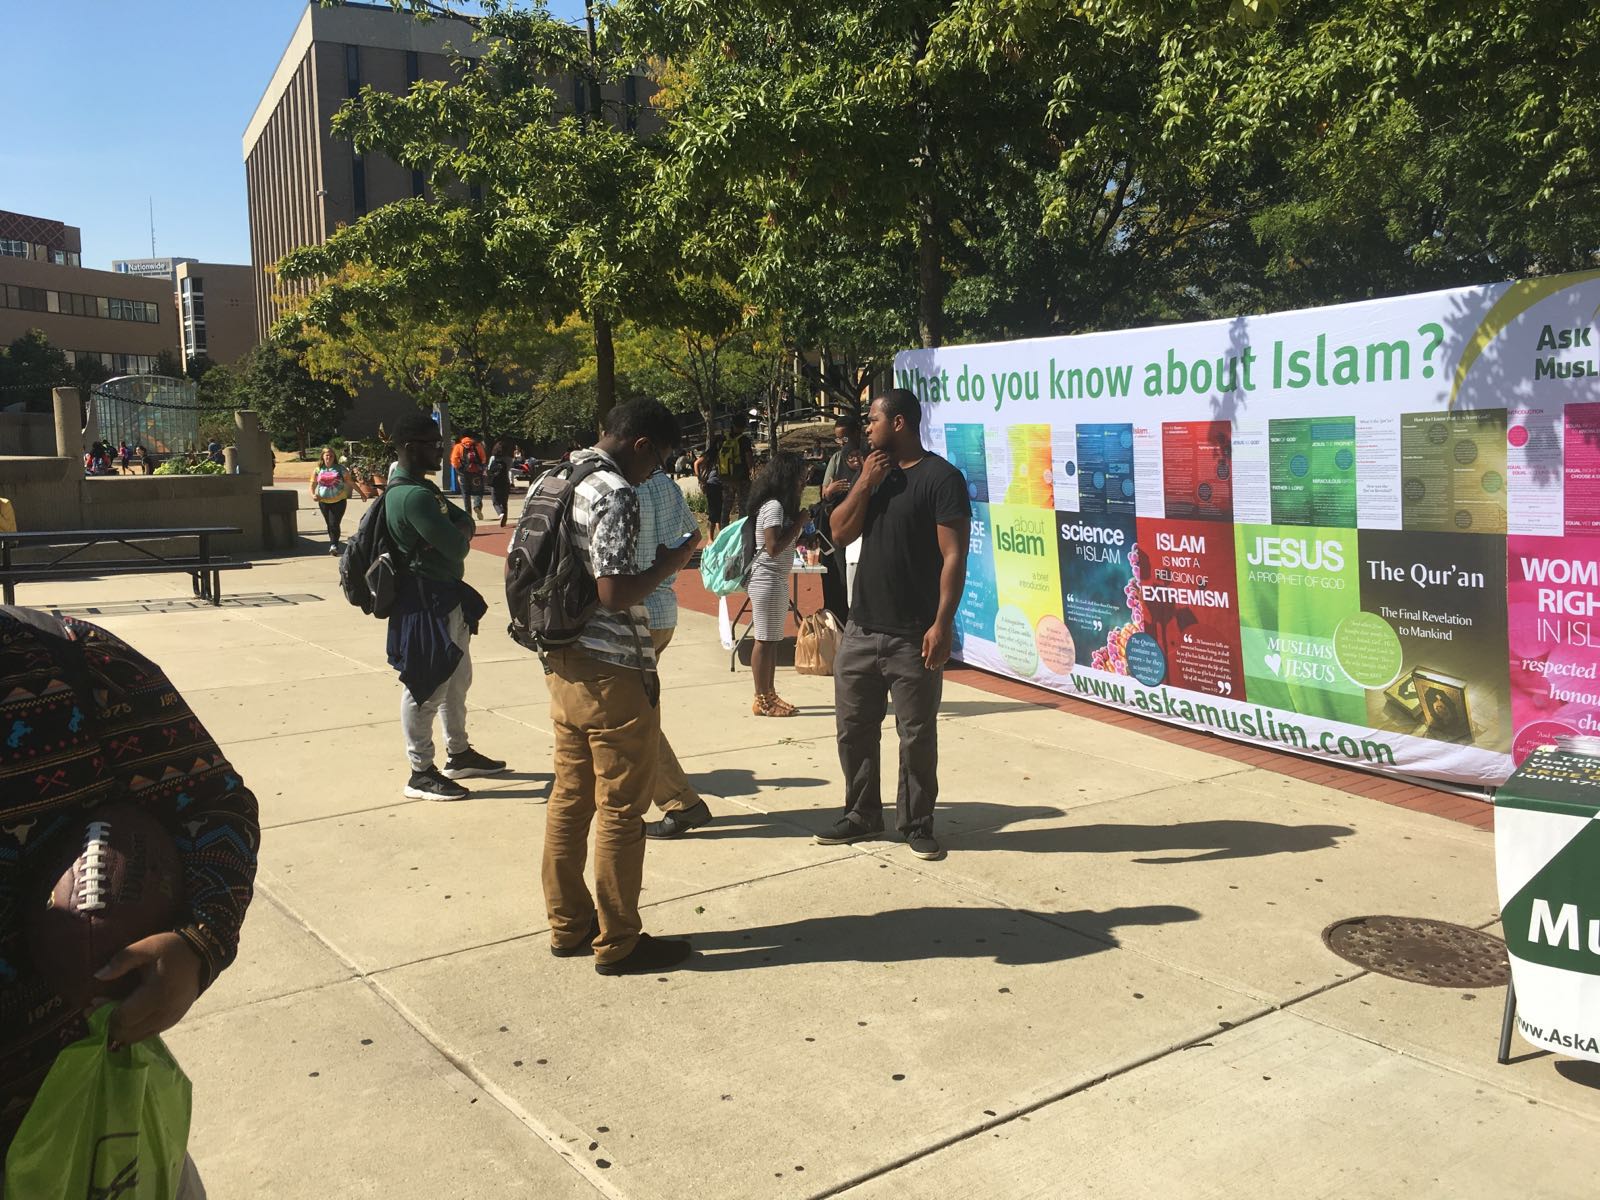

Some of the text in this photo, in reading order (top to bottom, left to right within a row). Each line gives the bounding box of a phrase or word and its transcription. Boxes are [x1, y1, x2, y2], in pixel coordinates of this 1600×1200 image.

[128, 262, 165, 272] Nationwide
[895, 322, 1445, 412] What do you know about Islam?
[1014, 516, 1045, 535] about
[1061, 520, 1125, 546] science
[996, 524, 1045, 556] Islam
[1156, 532, 1206, 554] ISLAM
[1075, 544, 1121, 565] in ISLAM
[1162, 556, 1200, 568] IS NOT A
[1247, 536, 1345, 572] JESUS
[1154, 569, 1209, 587] RELIGION OF
[1248, 571, 1345, 590] A PROPHET OF GOD
[1366, 560, 1485, 589] The Qur'an
[1520, 557, 1600, 586] WOM
[1142, 586, 1229, 609] EXTREMISM
[1538, 588, 1600, 616] RIGH
[1380, 606, 1473, 627] The Final Revelation
[1399, 626, 1453, 641] to Mankind
[1537, 618, 1600, 648] IN ISL
[1267, 637, 1334, 660] MUSLIMS
[1284, 660, 1336, 683] JESUS
[1521, 659, 1598, 679] respected
[1071, 672, 1398, 766] www.askamuslim.com
[1516, 772, 1564, 782] John
[1524, 767, 1582, 779] TRUE
